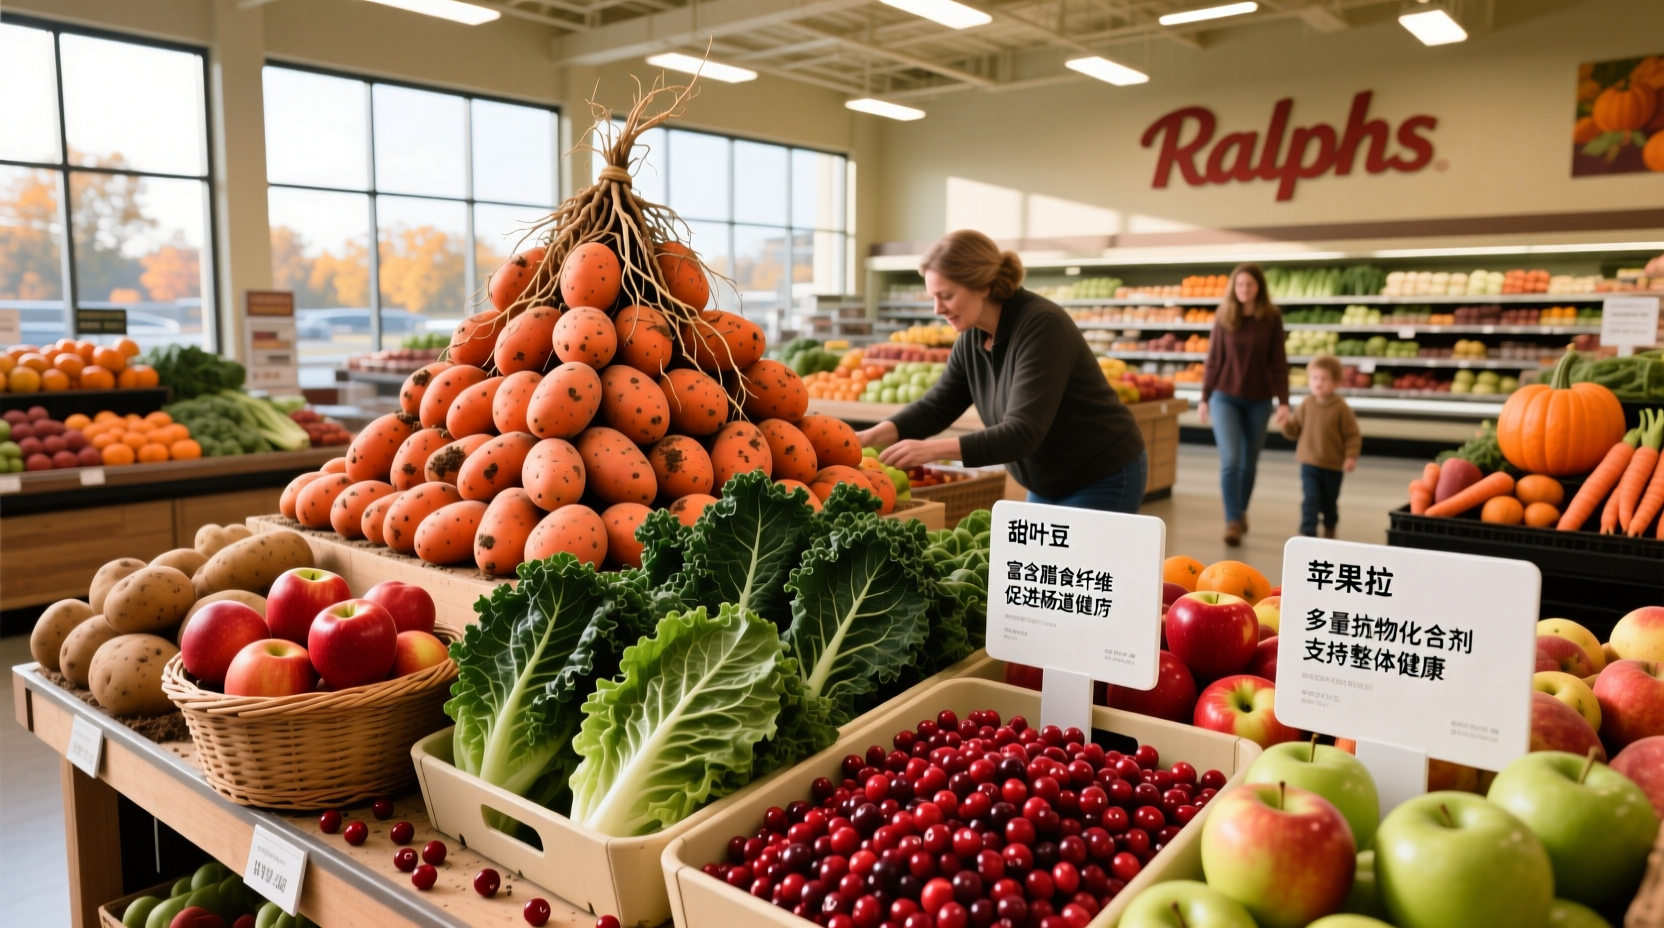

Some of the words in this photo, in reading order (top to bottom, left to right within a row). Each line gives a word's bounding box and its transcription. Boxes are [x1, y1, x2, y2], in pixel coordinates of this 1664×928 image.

[1140, 90, 1438, 201] Ralphs
[1008, 518, 1070, 549] 甜叶豆
[1307, 559, 1394, 598] 苹果拉
[1303, 637, 1447, 682] 支持整体健康
